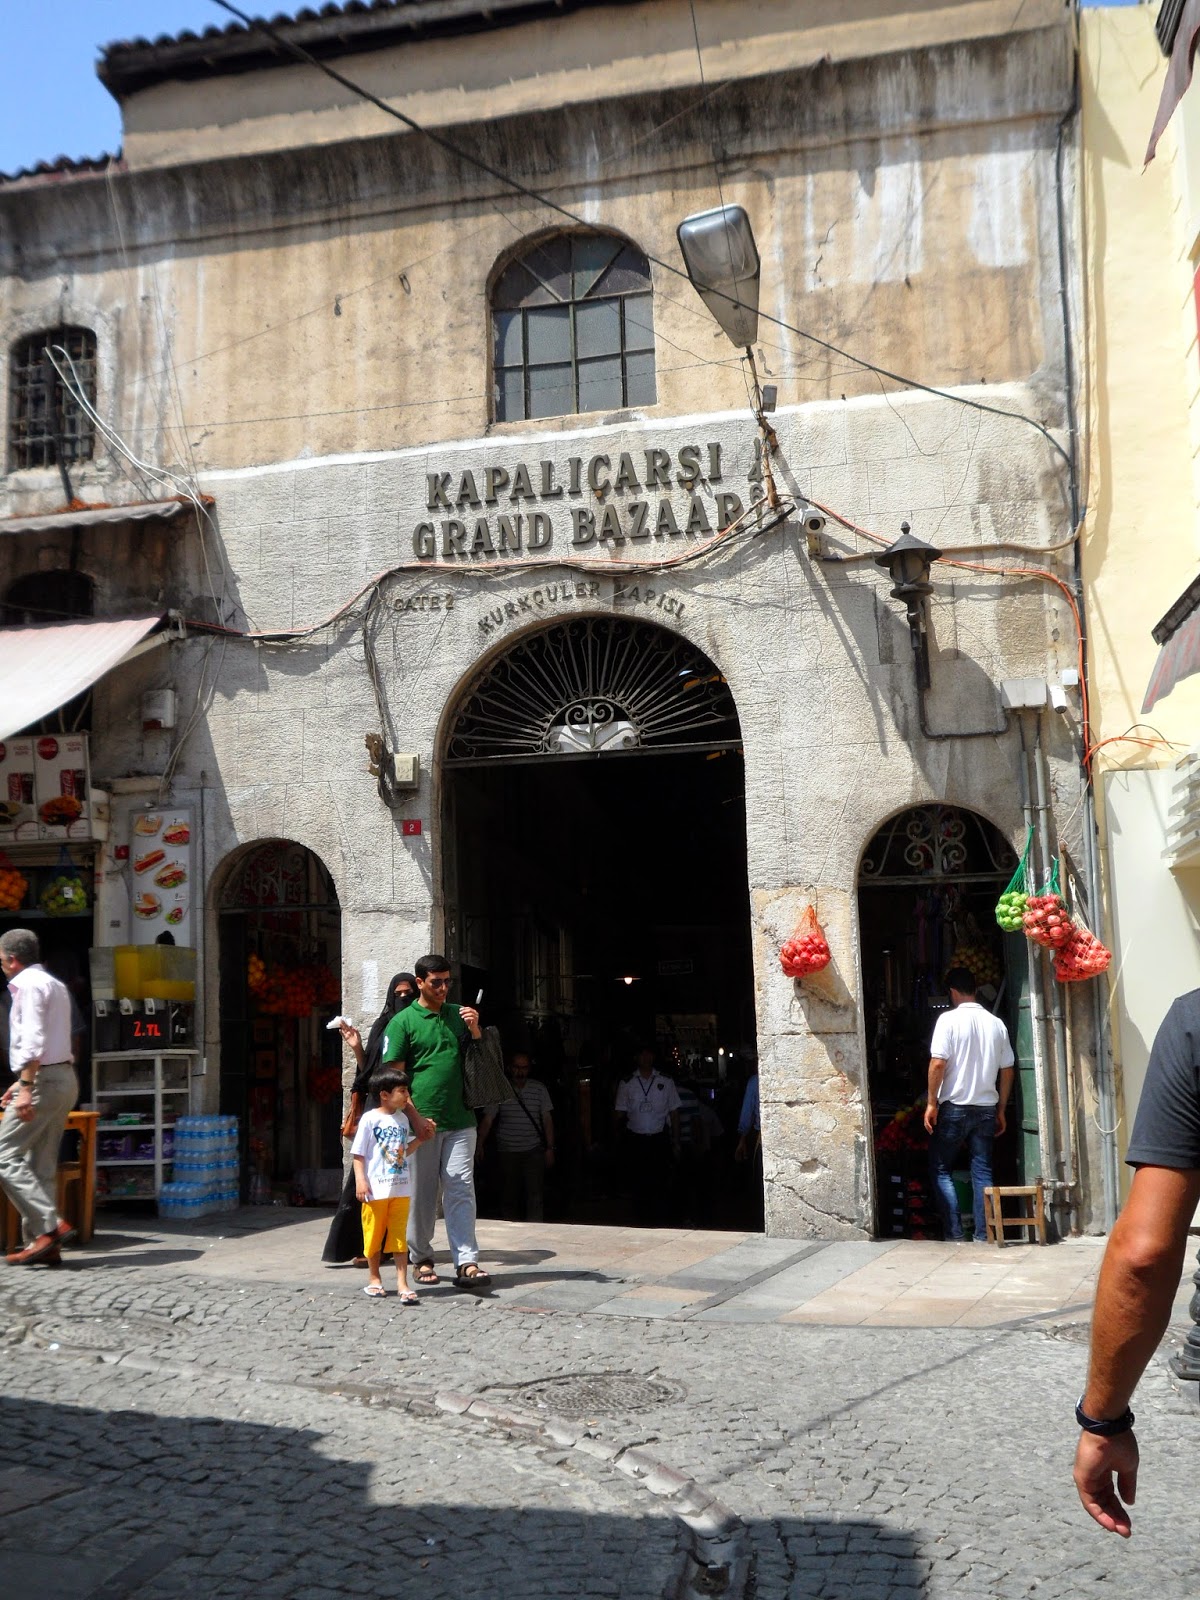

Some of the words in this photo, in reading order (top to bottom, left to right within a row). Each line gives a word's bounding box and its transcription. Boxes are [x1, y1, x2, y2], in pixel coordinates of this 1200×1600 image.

[412, 511, 551, 558] GRAND
[570, 491, 744, 545] BAZAAR
[394, 596, 440, 611] GATE
[445, 593, 454, 610] 2
[612, 582, 686, 620] KAPISI
[408, 823, 416, 832] 2
